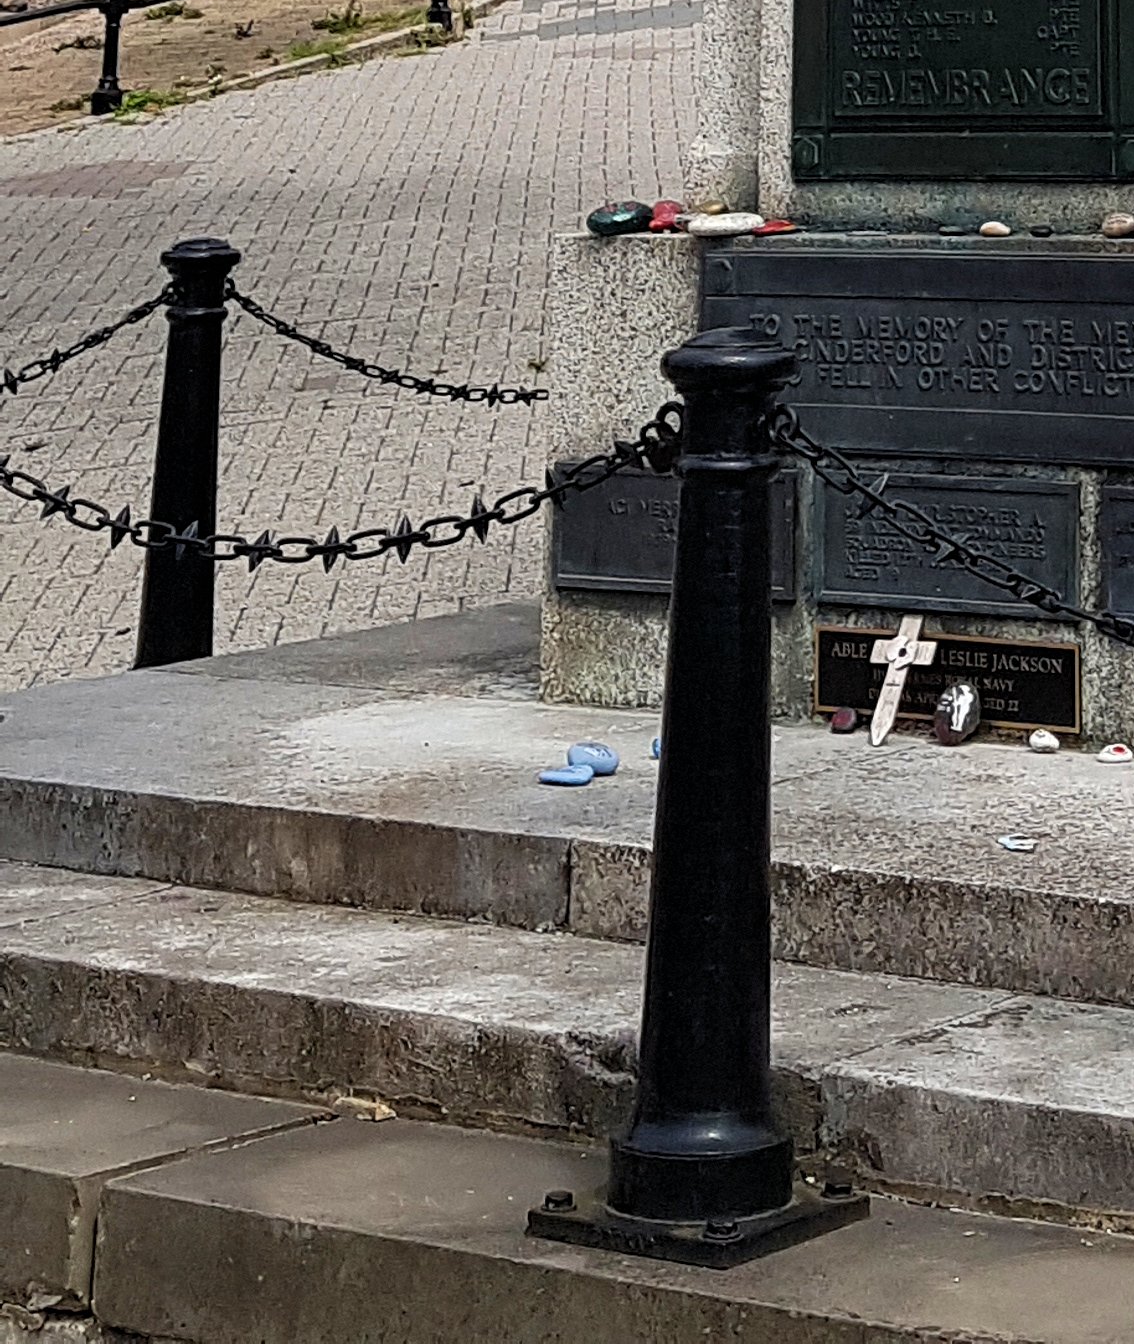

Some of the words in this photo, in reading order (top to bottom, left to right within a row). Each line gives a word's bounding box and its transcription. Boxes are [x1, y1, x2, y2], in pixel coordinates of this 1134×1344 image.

[841, 68, 1090, 106] REMEMBRANCE
[750, 313, 780, 337] TO
[794, 314, 842, 338] THE
[857, 315, 964, 343] MEMORY
[976, 318, 1009, 343] OF
[1023, 319, 1075, 344] THE
[796, 340, 945, 366] CINDERFORD
[963, 343, 1012, 368] AND
[817, 364, 873, 390] FELL
[878, 365, 904, 390] IN
[917, 366, 1003, 394] OTHER
[831, 642, 868, 659] ABLE
[940, 650, 989, 670] LESLIE
[991, 655, 1064, 675] JACKSON
[981, 676, 1016, 693] NAVY
